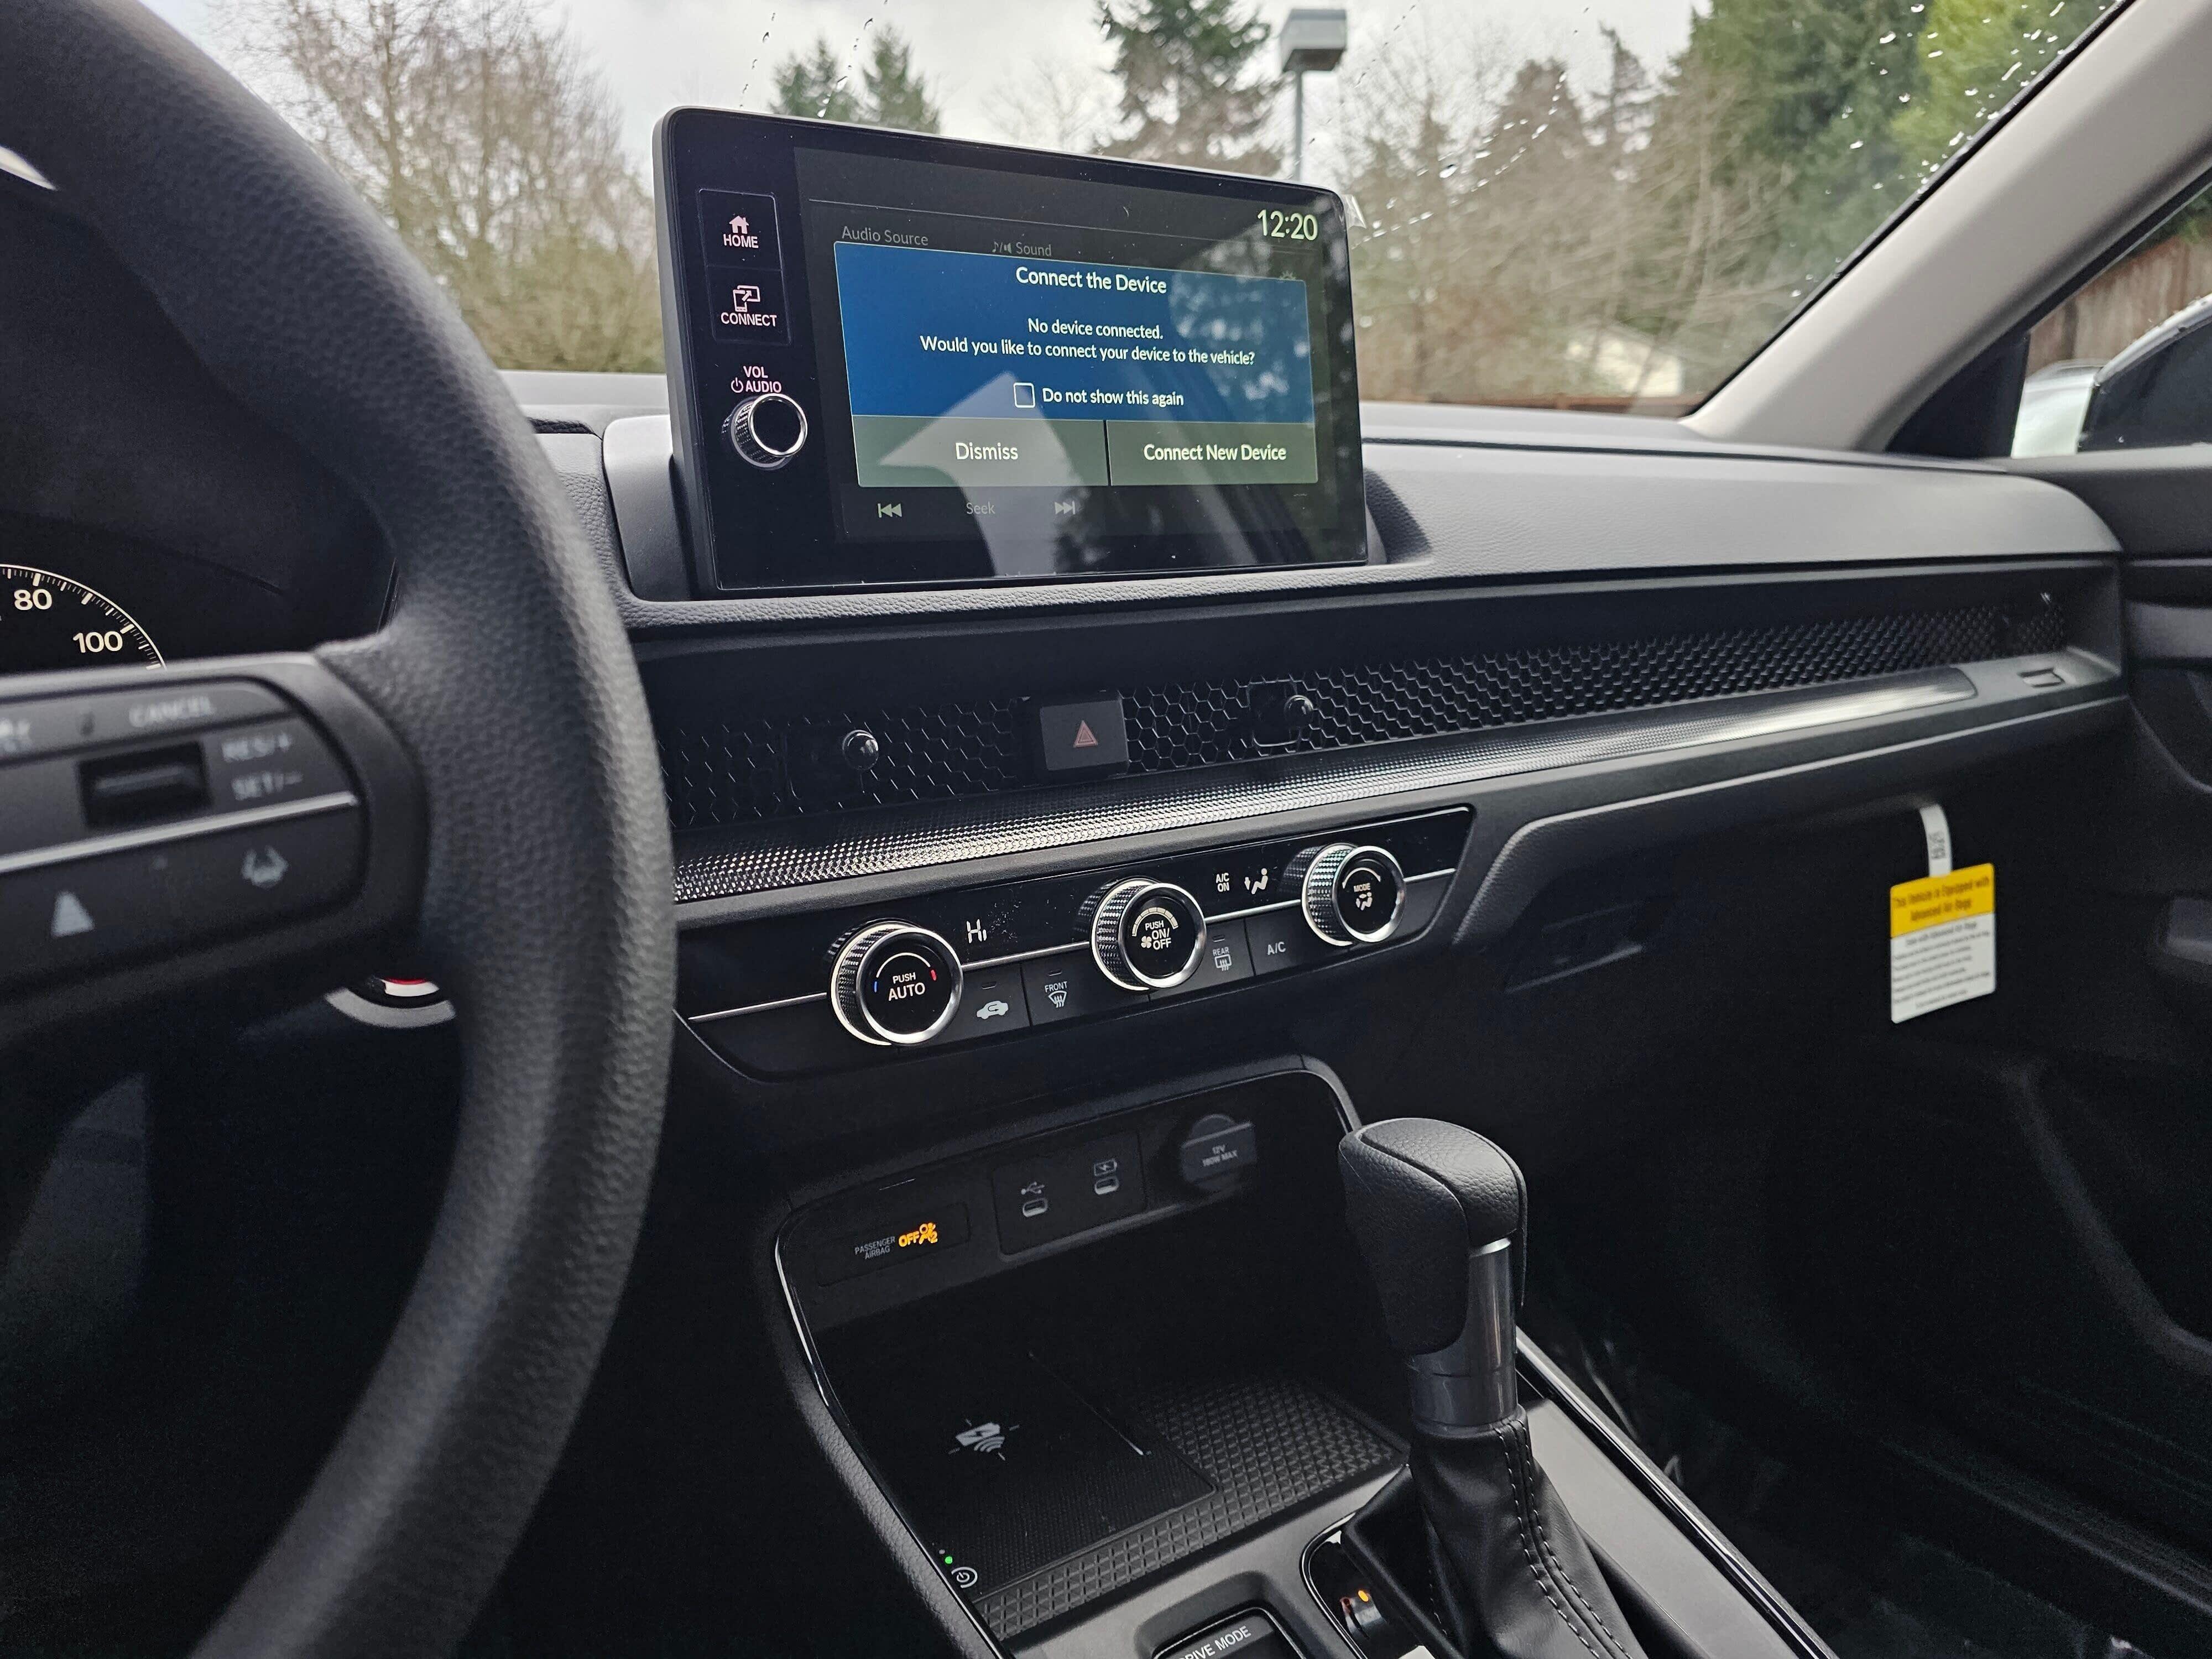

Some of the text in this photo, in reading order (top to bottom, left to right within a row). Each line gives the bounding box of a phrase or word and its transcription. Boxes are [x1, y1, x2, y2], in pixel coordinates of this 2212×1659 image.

[1257, 209, 1318, 241] 12:20
[723, 233, 758, 249] HOME
[842, 226, 928, 246] Audio Source
[1016, 242, 1052, 257] Sound
[1015, 267, 1167, 294] Connect the Device
[721, 312, 777, 327] CONNECT
[1027, 318, 1164, 340] No device connected.
[920, 336, 1255, 365] Would you like to connect your device to the vehicle?
[743, 366, 768, 378] VOL
[745, 380, 782, 393] AUDIO
[1042, 388, 1184, 407] Do not show this again
[955, 442, 1019, 461] Dismiss
[1143, 444, 1286, 460] Connect New Device
[966, 502, 994, 515] Seek
[13, 588, 53, 611] 80
[72, 631, 123, 653] 100
[1215, 872, 1229, 884] A/C
[1217, 881, 1229, 892] ON
[1353, 883, 1371, 892] MODE
[1145, 920, 1165, 931] PUSH
[1151, 928, 1171, 941] ON/
[1152, 938, 1172, 951] OFF
[1212, 947, 1230, 956] REAR
[1266, 941, 1287, 956] A/C
[892, 971, 917, 984] PUSH
[888, 982, 926, 1001] AUTO
[1045, 980, 1068, 993] FRONT
[854, 1236, 895, 1255] PASSENGER
[898, 1231, 920, 1247] OFF
[865, 1245, 890, 1259] AIRBAG
[1178, 1625, 1251, 1659] RIVE MODE
